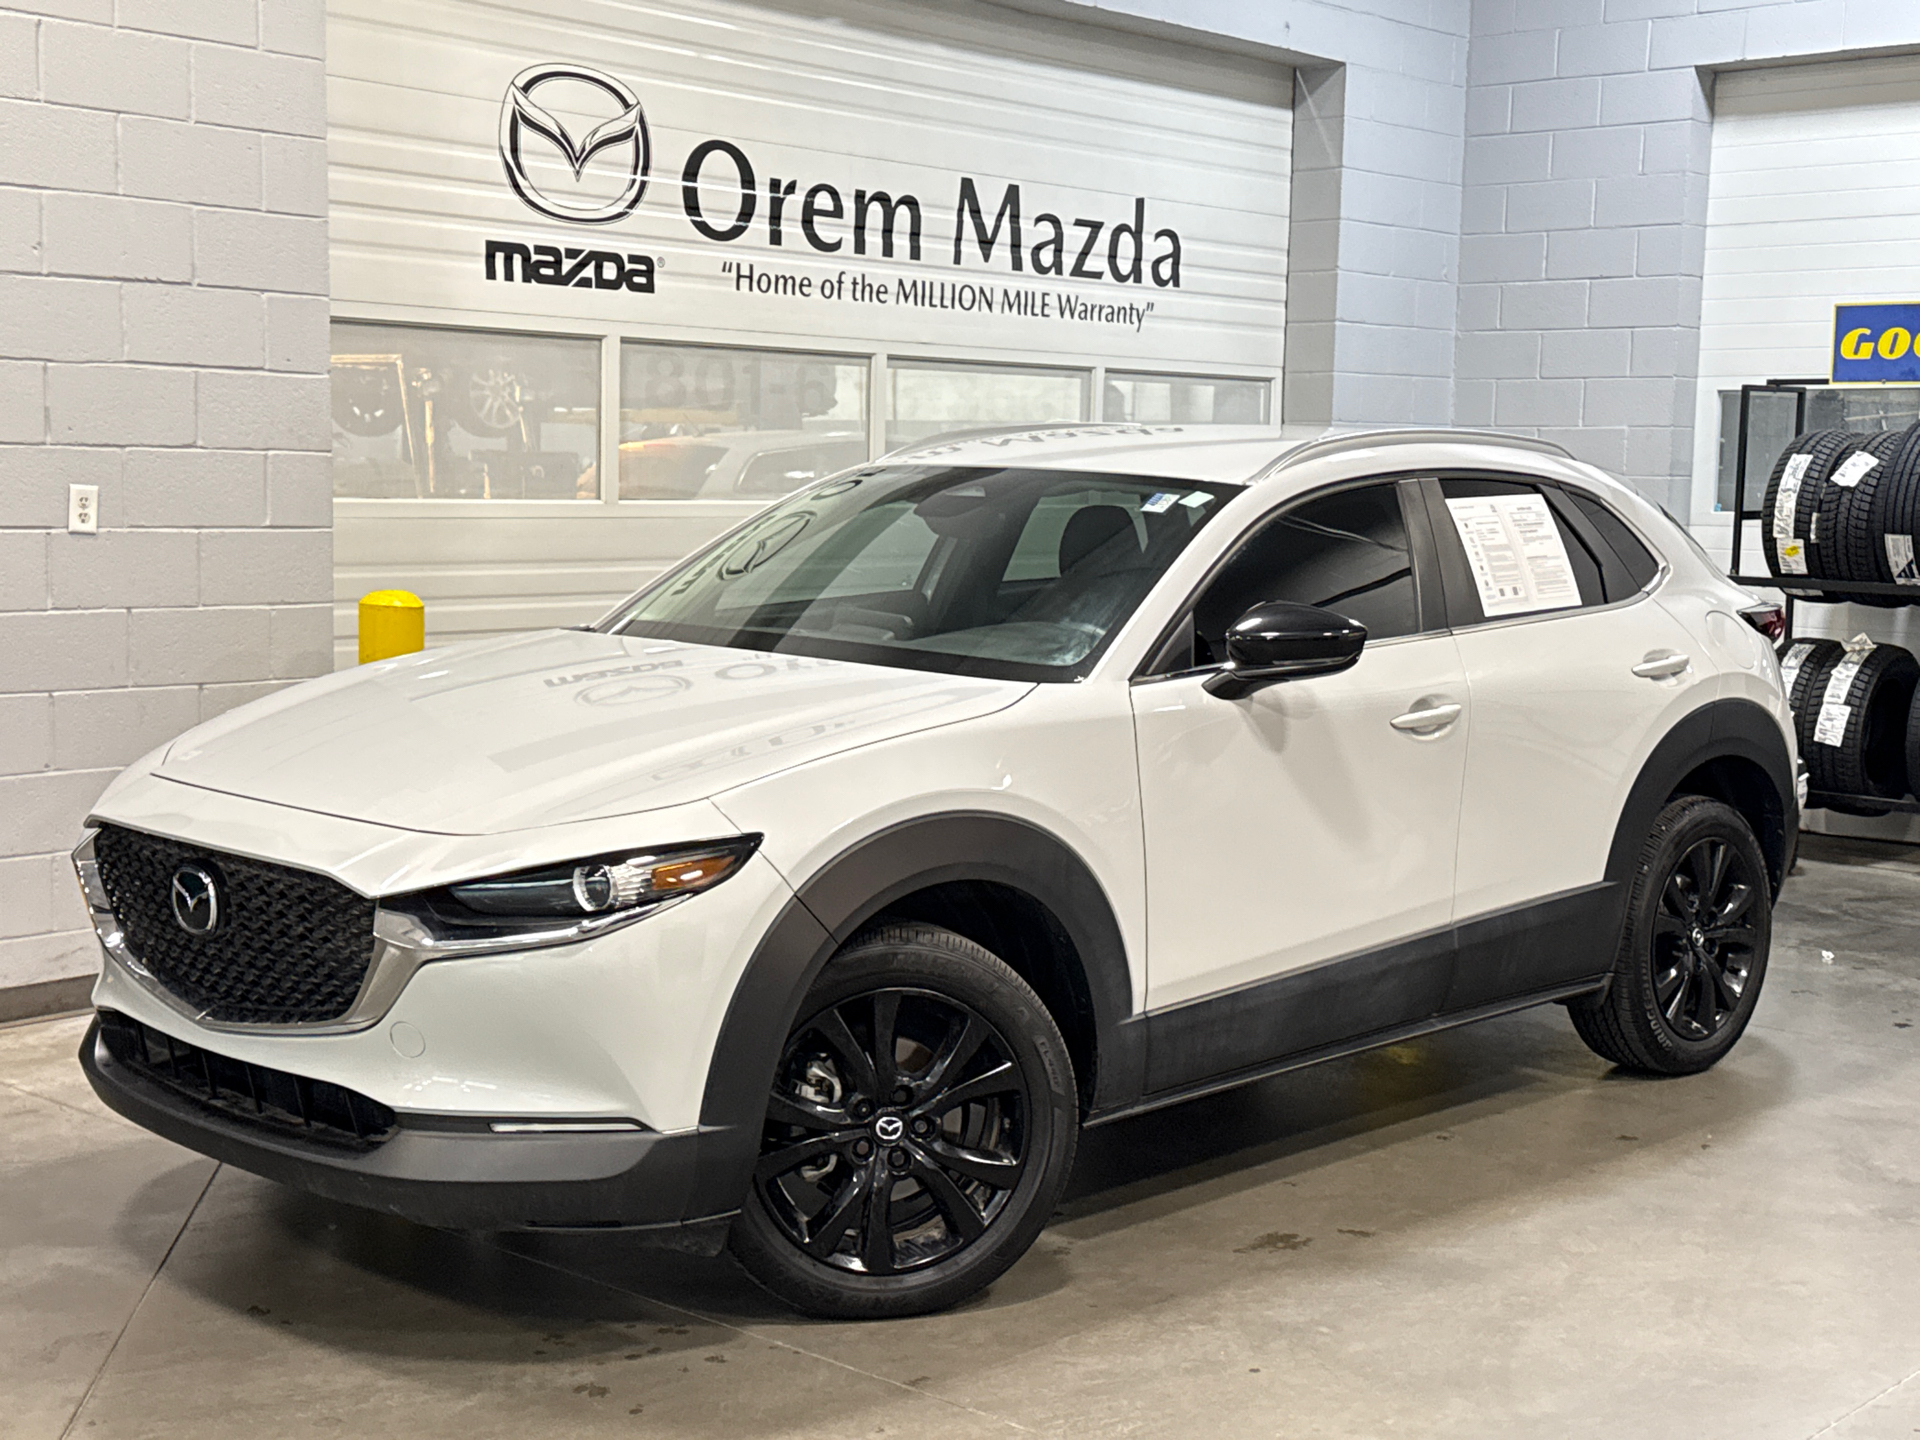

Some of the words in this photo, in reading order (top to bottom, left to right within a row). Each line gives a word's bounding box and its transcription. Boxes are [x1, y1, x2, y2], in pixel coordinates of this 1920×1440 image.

[681, 139, 922, 261] Orem
[953, 176, 1182, 288] Mazda
[485, 240, 655, 294] mazda
[721, 262, 812, 298] “Home
[820, 271, 846, 300] of
[851, 273, 889, 304] the
[896, 278, 994, 313] MILLION
[1001, 288, 1050, 318] MILE
[1057, 293, 1155, 333] Warranty”
[1840, 326, 1920, 360] GO
